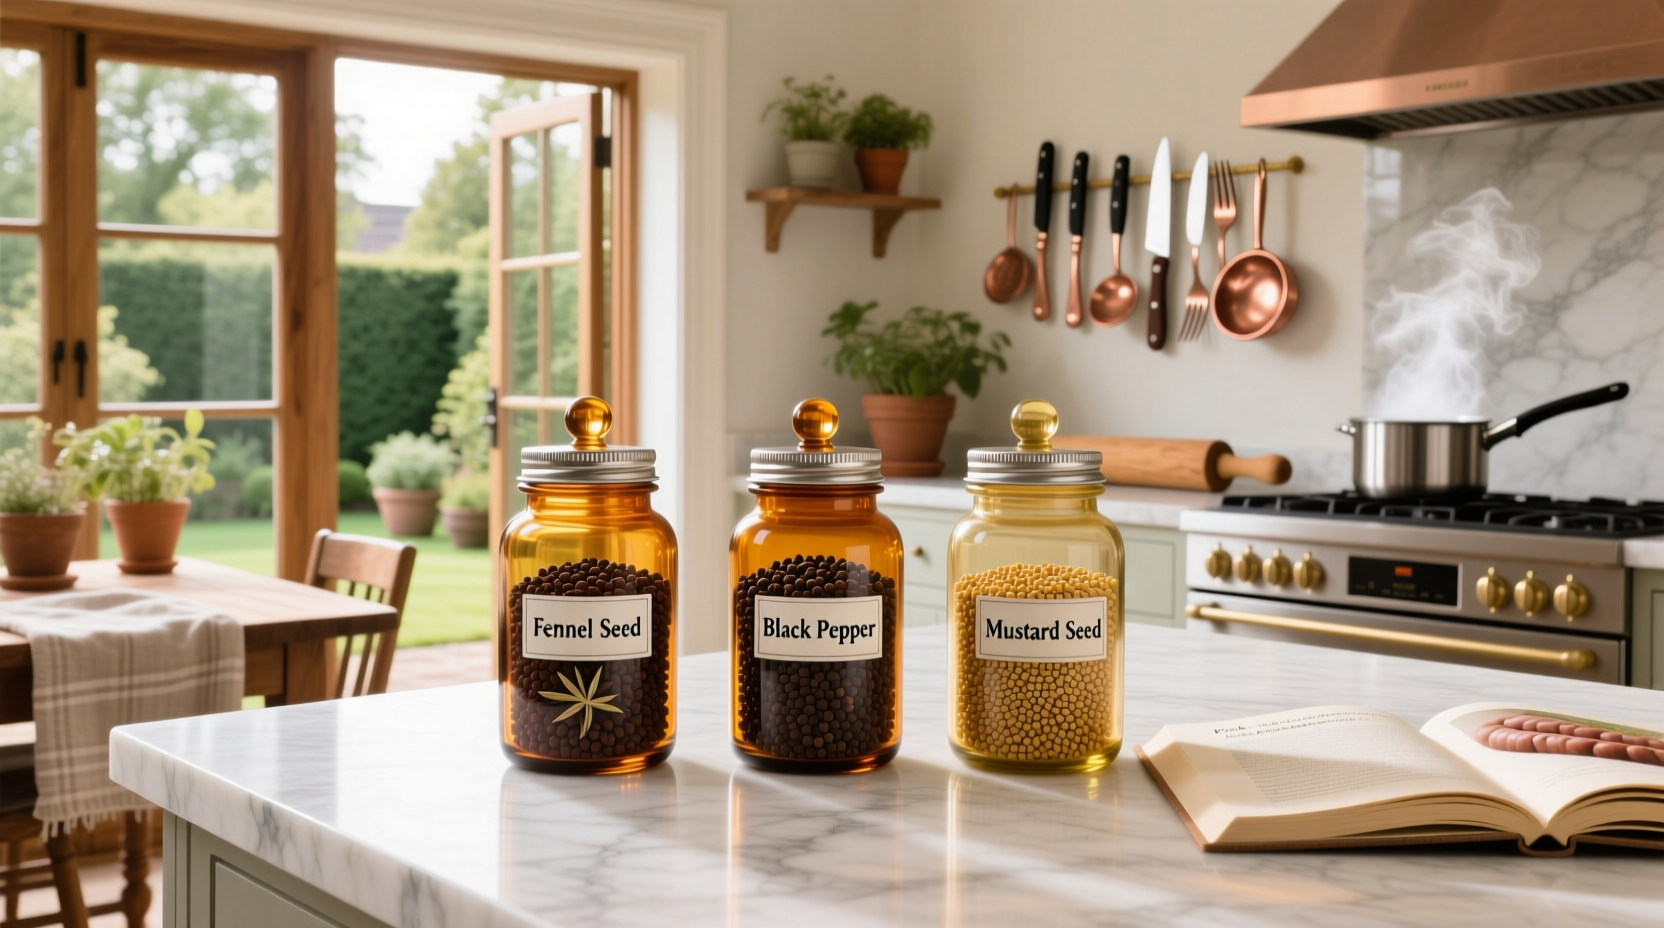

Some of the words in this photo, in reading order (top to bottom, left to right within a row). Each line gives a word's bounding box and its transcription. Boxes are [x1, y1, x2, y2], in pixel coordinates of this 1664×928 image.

[533, 617, 593, 639] Fennel
[600, 616, 641, 639] Seed
[763, 617, 811, 639] Black
[817, 619, 876, 645] Pepper
[986, 618, 1060, 640] Mustard
[1065, 618, 1101, 640] Seed
